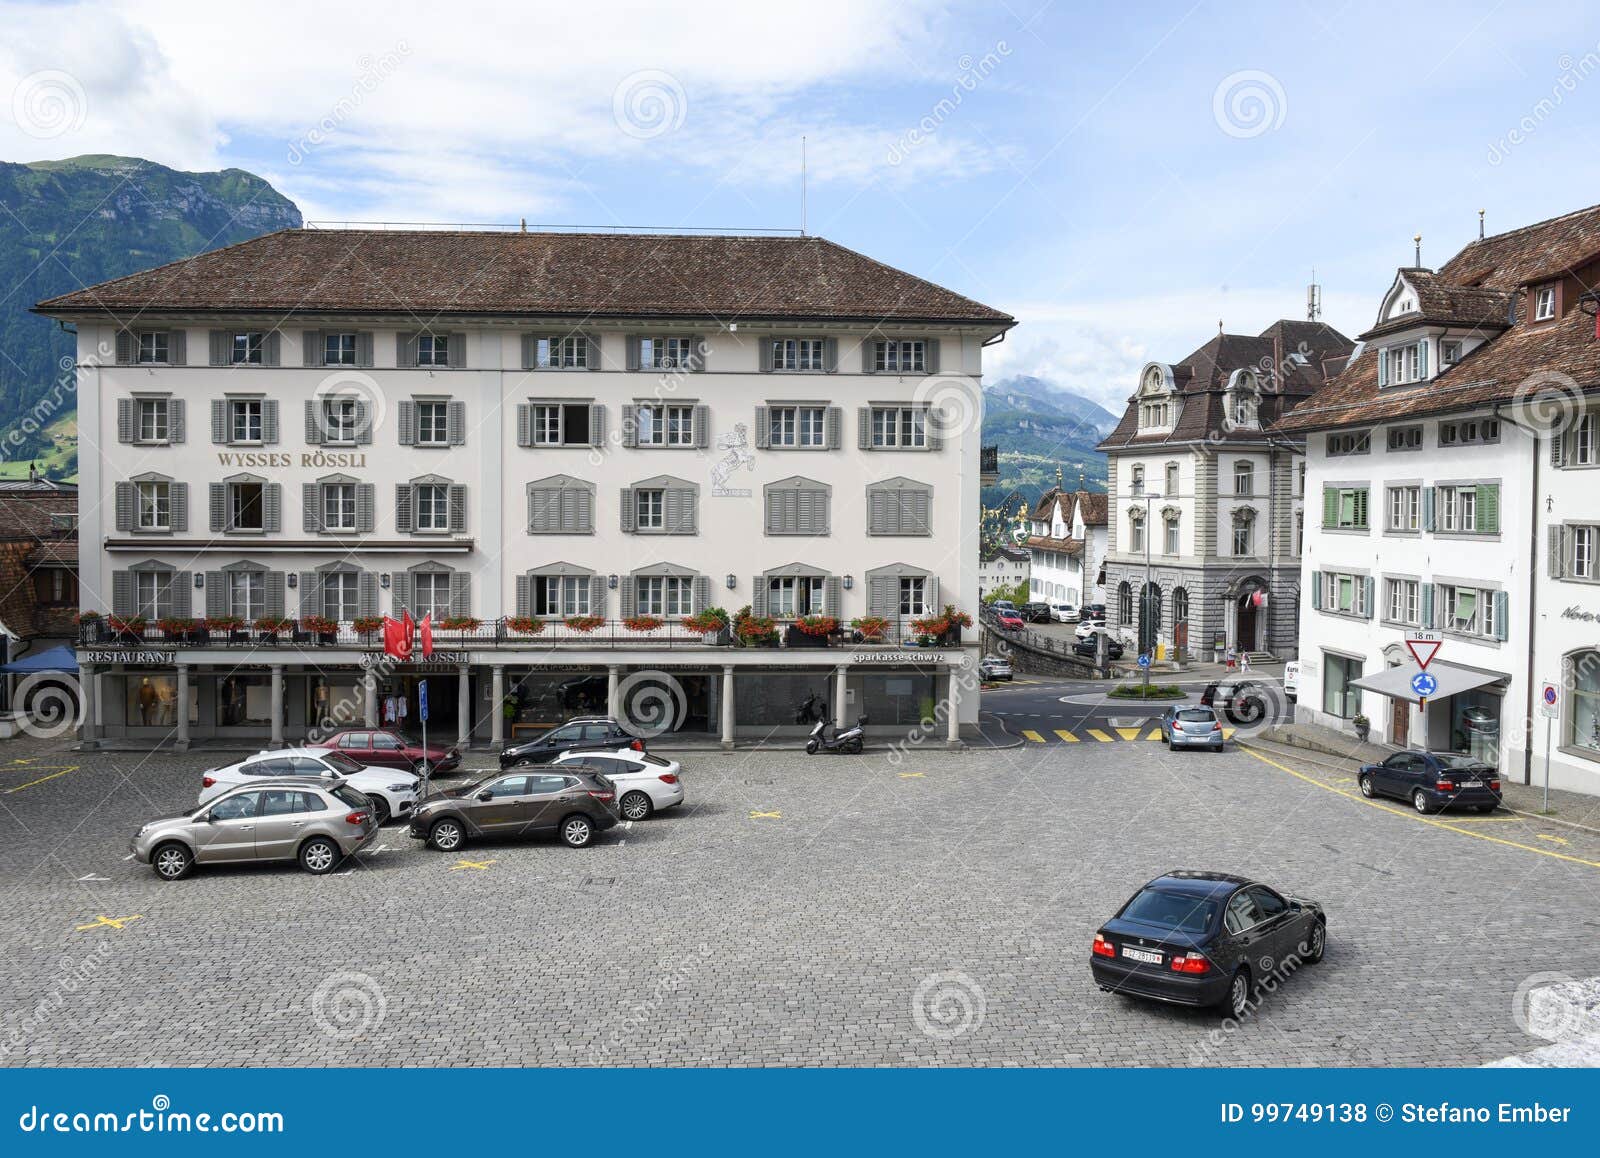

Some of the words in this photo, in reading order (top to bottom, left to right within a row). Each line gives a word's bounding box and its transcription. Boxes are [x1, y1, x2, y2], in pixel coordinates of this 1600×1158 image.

[218, 453, 291, 467] WYSSES
[301, 450, 366, 468] RÖSSLI
[1415, 632, 1424, 640] 18
[87, 651, 176, 662] RESTAURANT
[854, 652, 904, 663] sparkasse
[907, 652, 944, 663] schwyz
